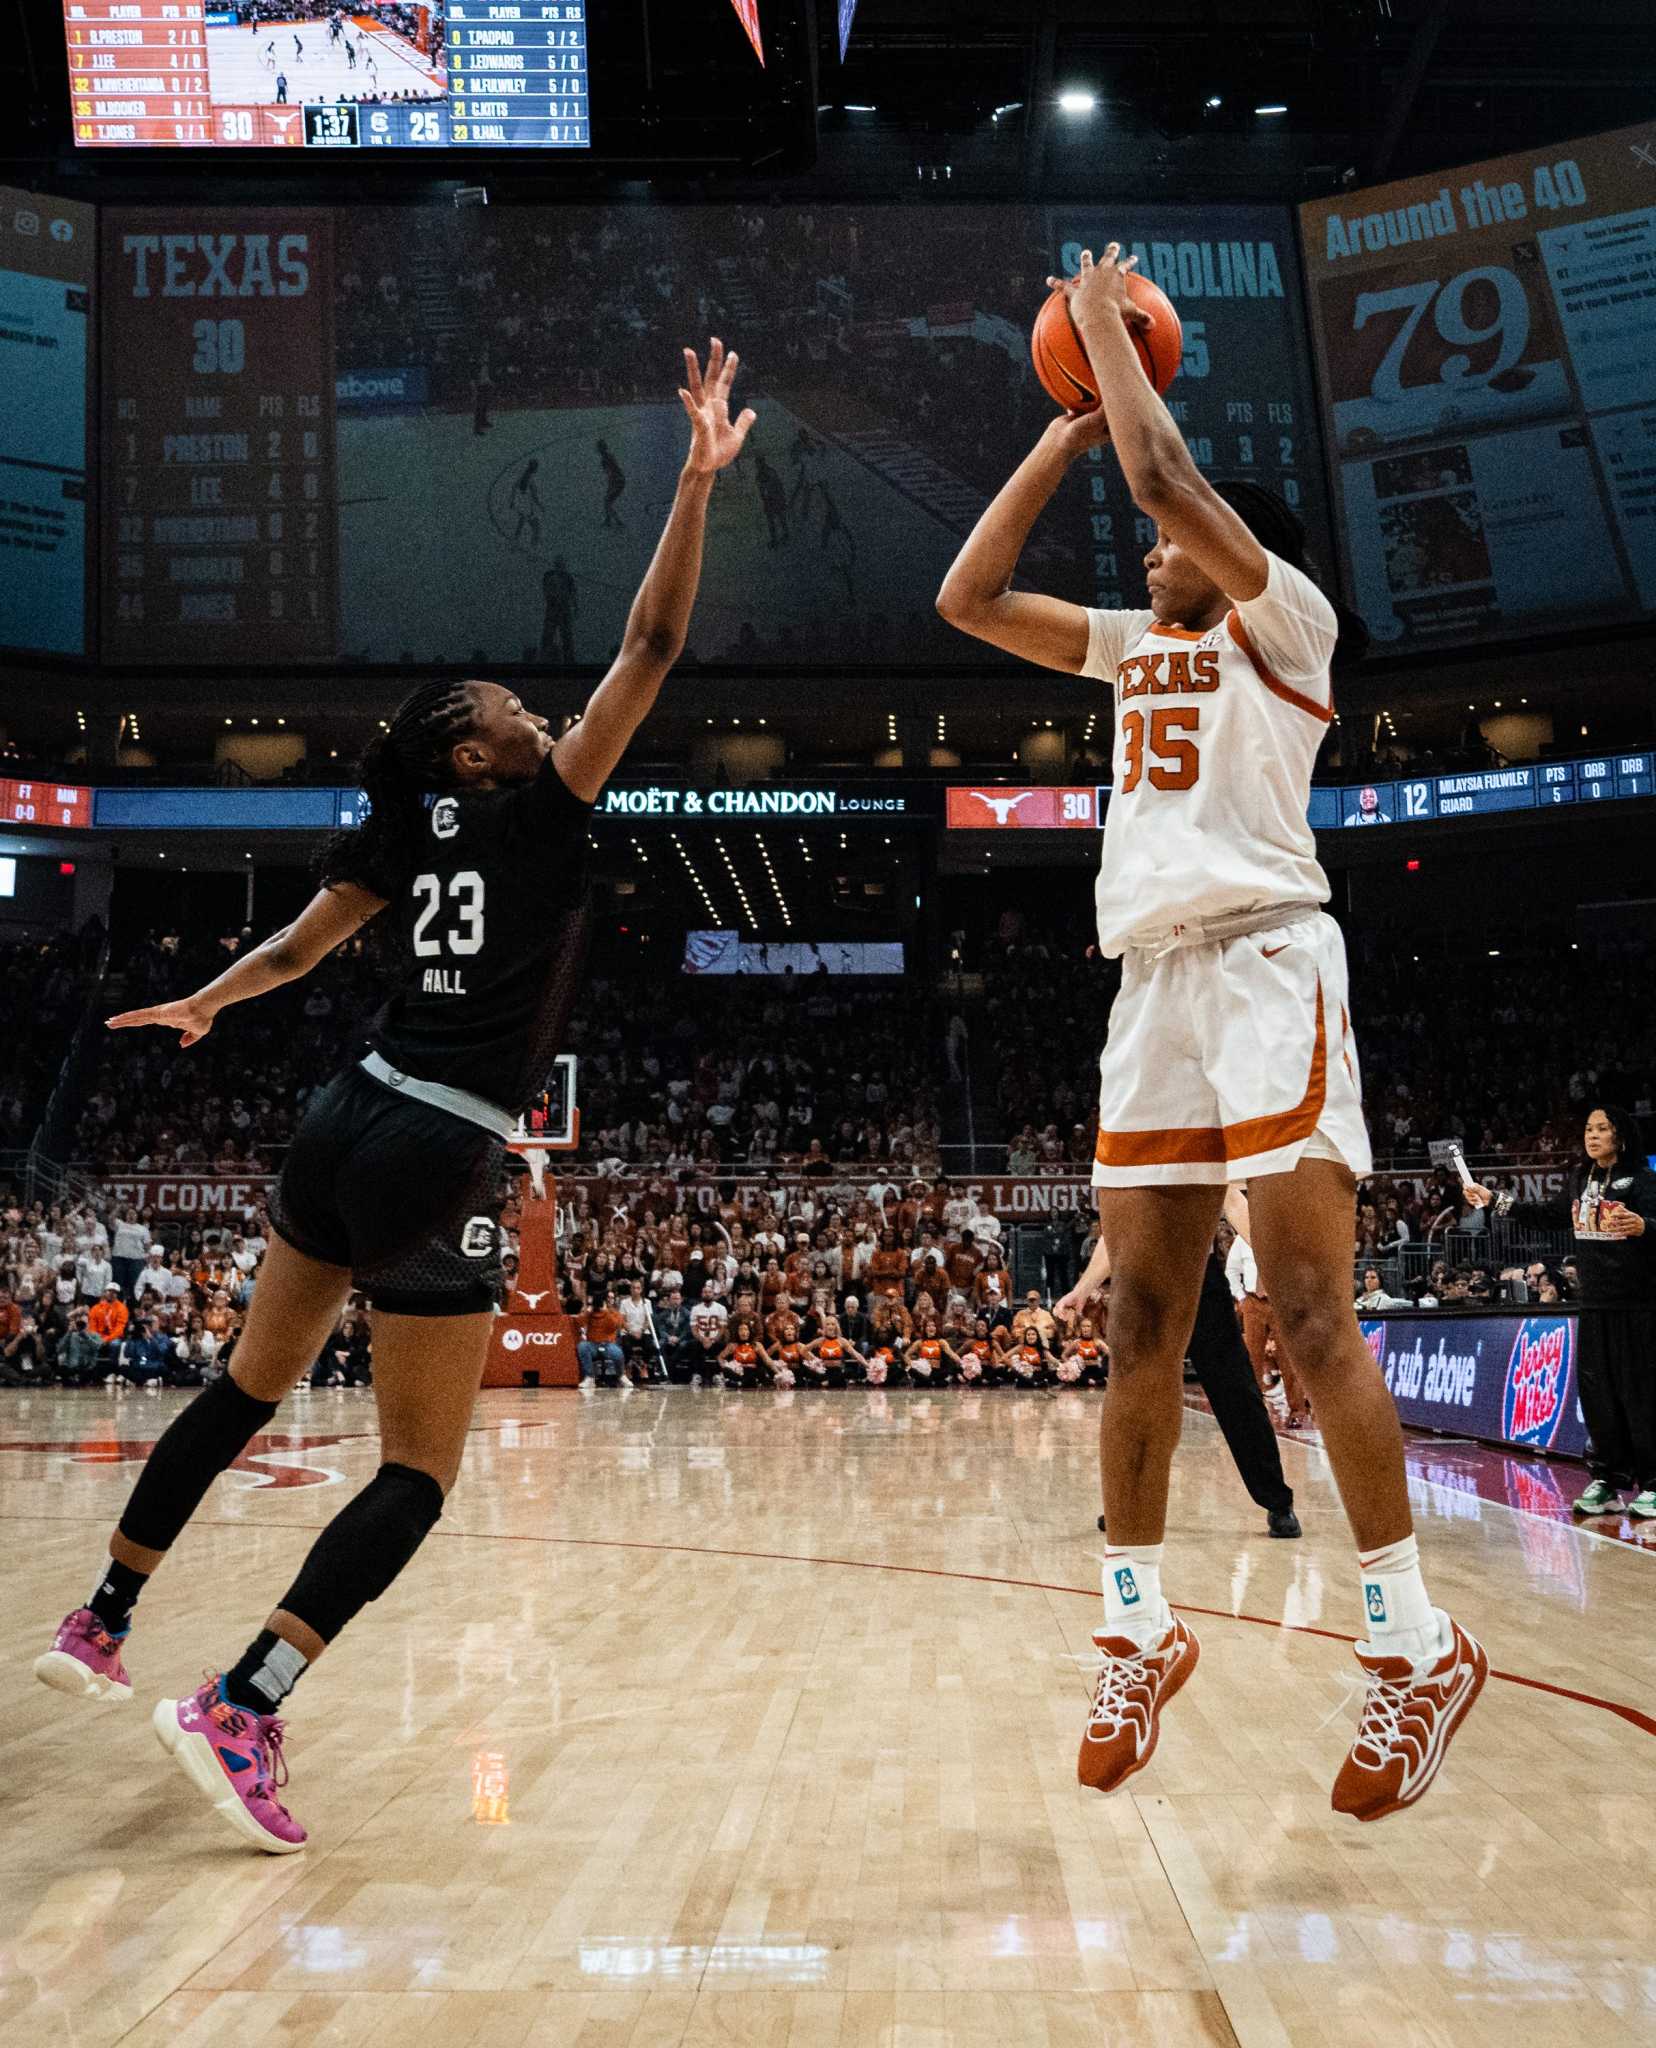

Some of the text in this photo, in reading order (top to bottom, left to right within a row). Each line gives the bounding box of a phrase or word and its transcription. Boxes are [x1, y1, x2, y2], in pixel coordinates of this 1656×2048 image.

[488, 6, 521, 19] PLAYER
[542, 6, 559, 19] PTS
[565, 6, 581, 19] FLS
[168, 30, 177, 45] 2
[547, 30, 555, 45] 3
[569, 30, 578, 45] 2
[548, 54, 556, 69] 5
[570, 54, 579, 69] 0
[194, 77, 202, 93] 2
[549, 78, 557, 93] 5
[571, 78, 579, 93] 0
[453, 101, 466, 117] 21
[549, 101, 558, 117] 6
[573, 101, 580, 117] 1
[223, 111, 254, 141] 30
[313, 115, 349, 136] 1:37
[410, 111, 440, 141] 25
[550, 125, 559, 140] 0
[574, 125, 580, 140] 1
[1327, 160, 1586, 261] Around the 40
[123, 234, 310, 298] TEXAS
[1108, 242, 1284, 297] AROLINA
[1353, 264, 1531, 398] 79
[192, 318, 246, 374] 30
[1177, 320, 1211, 377] 5
[259, 396, 285, 418] PTS
[1226, 402, 1253, 423] PTS
[1268, 403, 1293, 424] FLS
[162, 433, 250, 463] PRESTON
[268, 431, 281, 458] 2
[1239, 435, 1253, 464] 3
[1278, 437, 1294, 465] 2
[1091, 476, 1299, 504] 8 0
[305, 513, 318, 540] 2
[1091, 514, 1113, 541] 12
[1095, 554, 1118, 577] 21
[1121, 707, 1200, 795] 35
[1485, 771, 1529, 791] FULWILEY
[1546, 758, 1643, 783] PTS ORB DRB
[605, 787, 905, 813] MOËT & CHANDON LOUNGE
[1403, 783, 1429, 816] 12
[1553, 779, 1637, 802] 5 0 1
[16, 804, 35, 820] 0-0
[1062, 793, 1090, 820] 30
[1440, 796, 1473, 814] GUARD
[412, 871, 485, 957] 23
[423, 968, 466, 994] HALL
[525, 1332, 562, 1345] razr
[1385, 1352, 1396, 1392] a
[1394, 1337, 1424, 1399] sub
[1424, 1337, 1476, 1407] above
